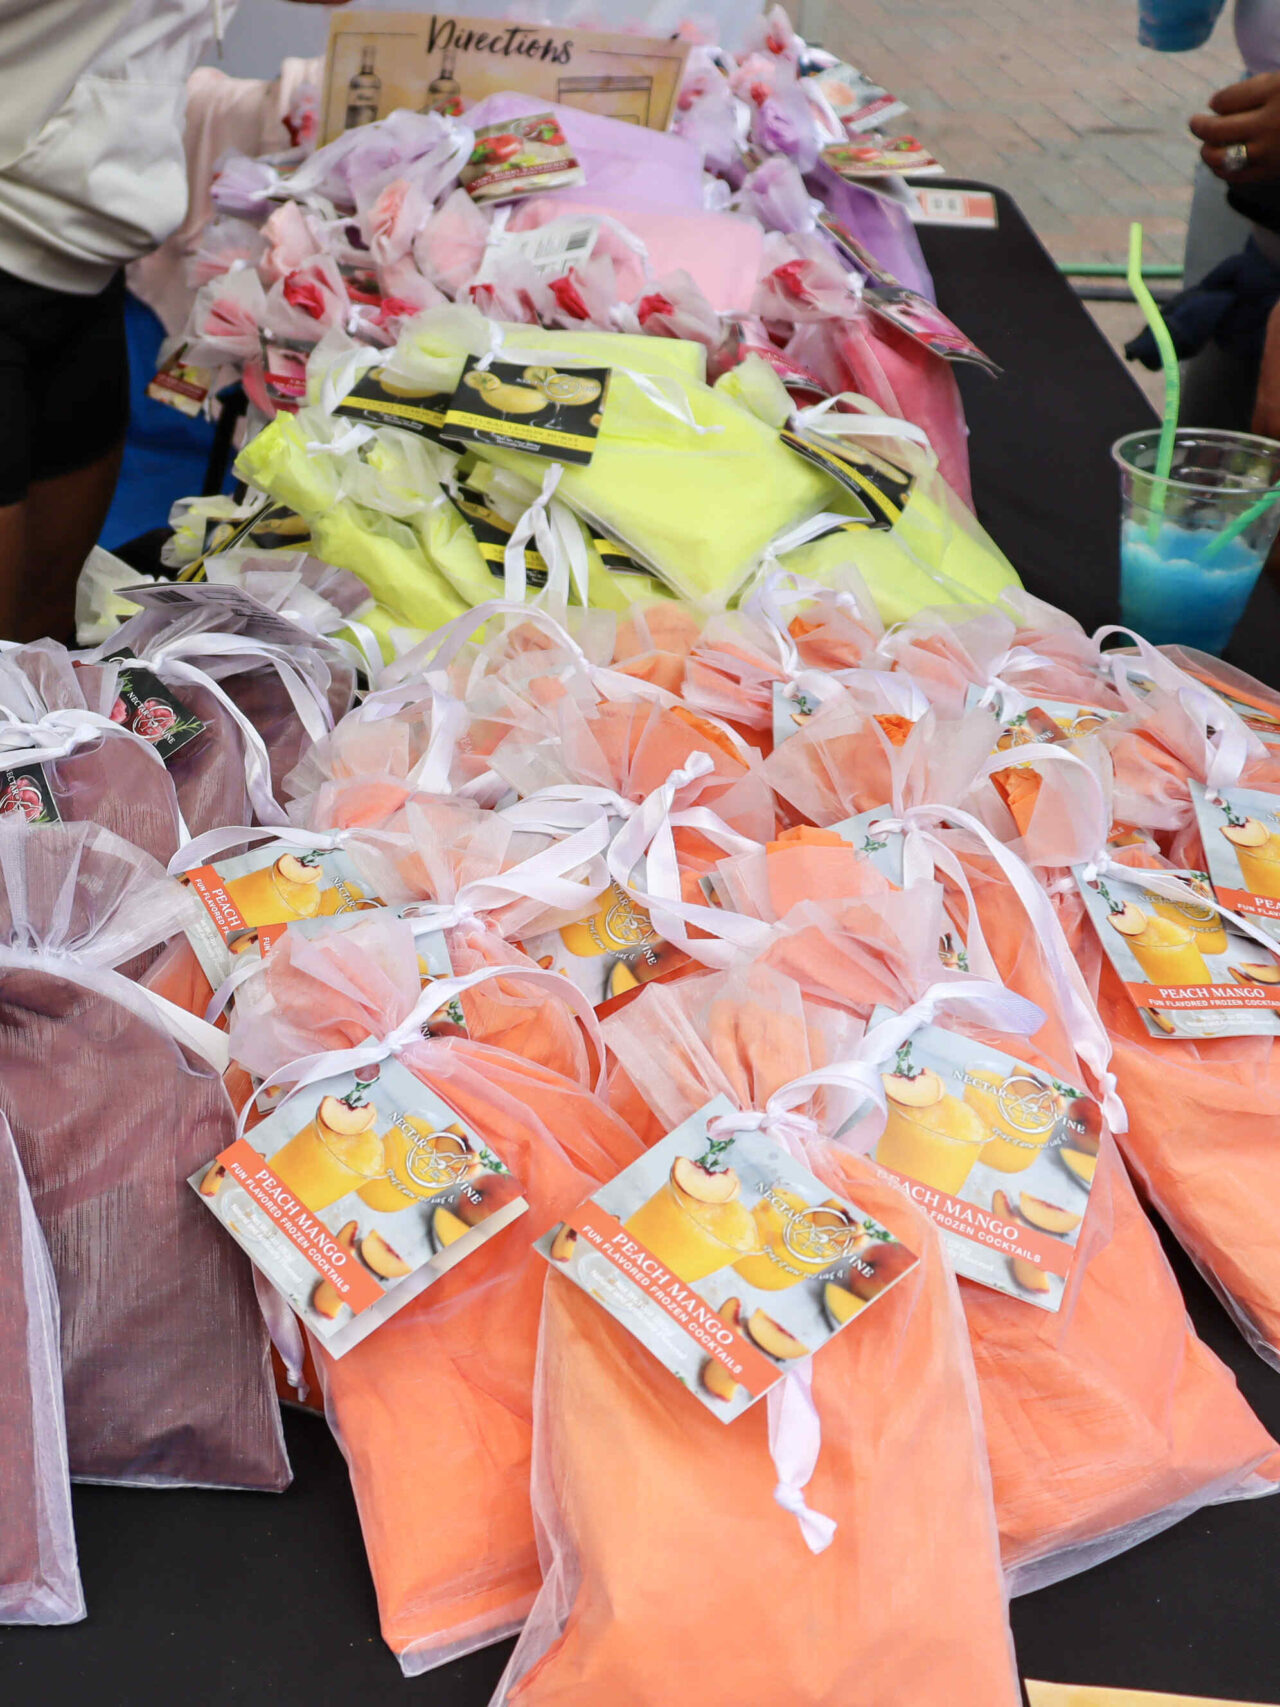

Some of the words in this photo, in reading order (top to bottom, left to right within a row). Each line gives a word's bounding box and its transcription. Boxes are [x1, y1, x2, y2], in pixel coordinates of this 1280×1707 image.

[426, 14, 574, 64] Directions
[126, 690, 149, 716] NECTAR
[3, 768, 20, 795] ECTAR
[194, 877, 206, 891] FUN
[202, 891, 224, 926] FLAVORED
[211, 886, 240, 927] PEACH
[332, 874, 357, 908] NECTAR
[1237, 903, 1256, 912] FUN
[639, 938, 658, 966] VINE
[1148, 998, 1166, 1006] FUN
[1166, 999, 1209, 1008] FLAVORED
[1210, 999, 1244, 1007] FROZEN
[1159, 987, 1209, 999] PEACH
[1211, 987, 1266, 999] MANGO
[953, 1070, 1007, 1099] NECTAR
[1053, 1113, 1087, 1135] VINE
[390, 1112, 428, 1148] NECTAR
[454, 1175, 483, 1205] VINE
[229, 1161, 248, 1181] FUN
[244, 1179, 283, 1219] FLAVORED
[278, 1216, 310, 1249] FROZEN
[305, 1246, 352, 1294] COCKTAILS
[252, 1167, 301, 1217] PEACH
[293, 1210, 349, 1268] MANGO
[756, 1182, 804, 1225] NECTAR
[842, 1249, 875, 1279] VINE
[929, 1209, 975, 1235] FROZEN
[976, 1229, 1042, 1264] COCKTAILS
[942, 1199, 1021, 1242] MANGO
[581, 1224, 603, 1245] FUN
[600, 1241, 650, 1288] FLAVORED
[648, 1284, 689, 1323] FROZEN
[685, 1320, 745, 1375] COCKTAILS
[610, 1230, 671, 1286] PEACH
[664, 1280, 736, 1347] MANGO
